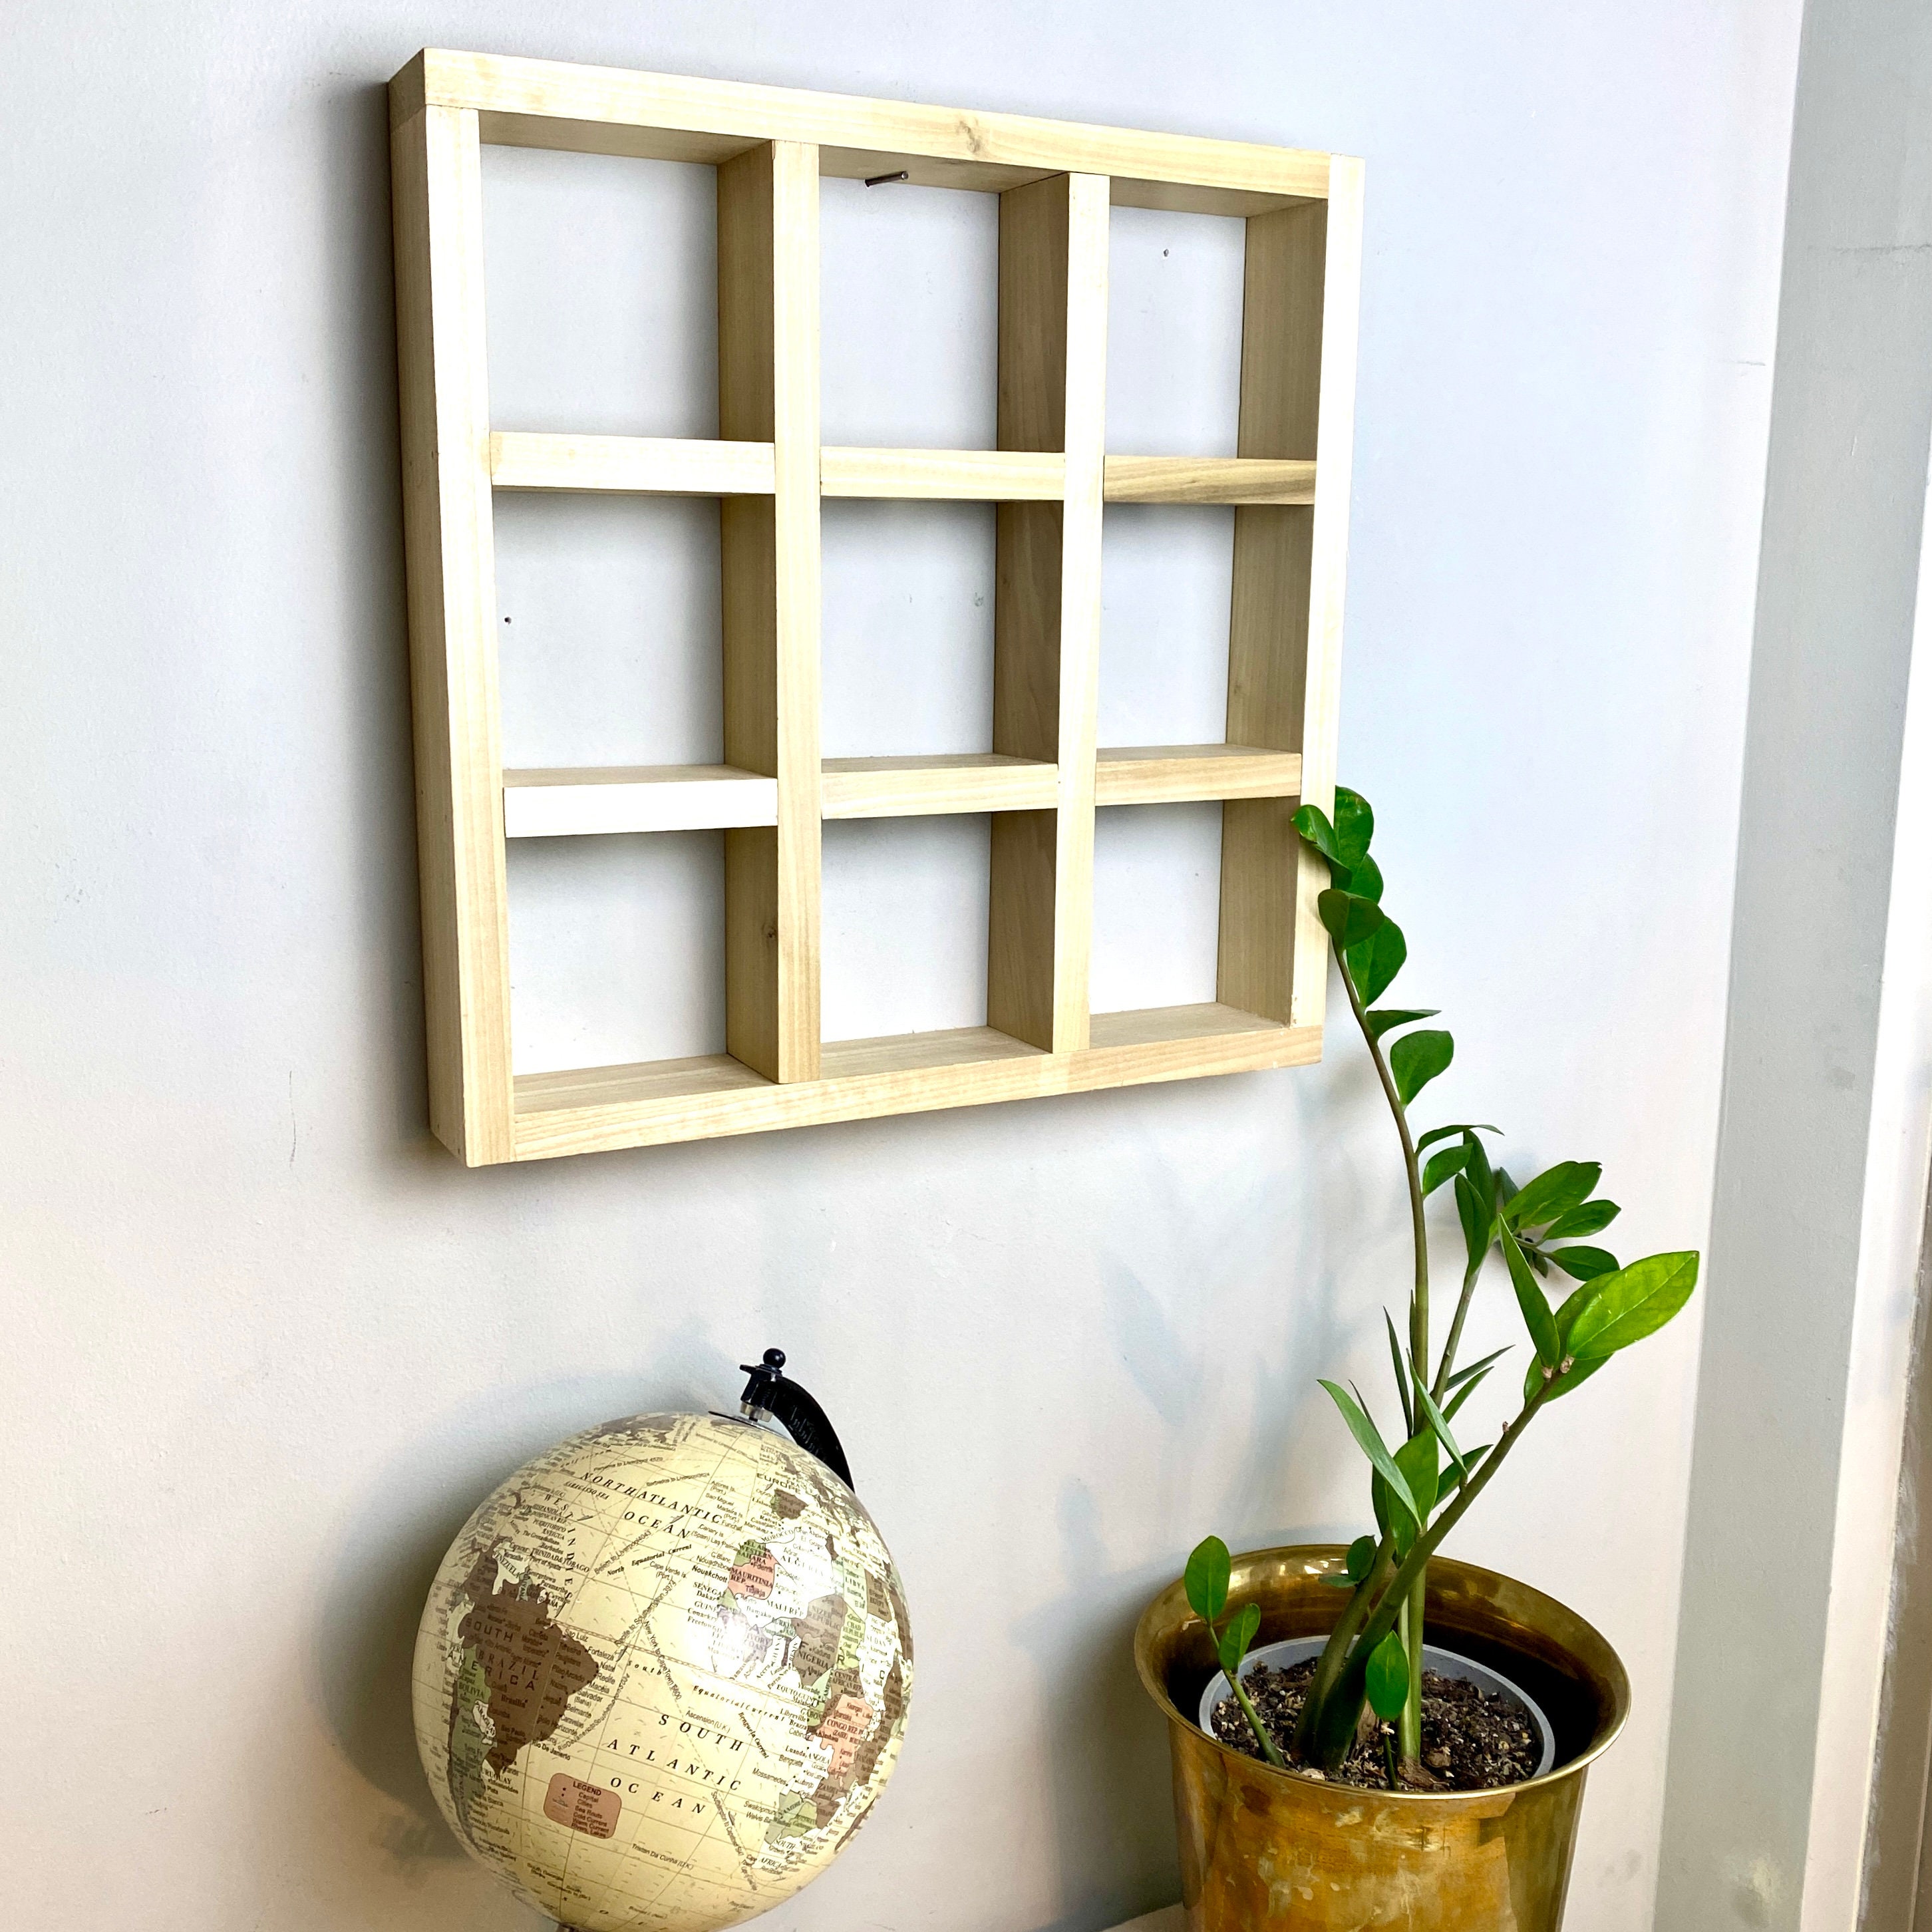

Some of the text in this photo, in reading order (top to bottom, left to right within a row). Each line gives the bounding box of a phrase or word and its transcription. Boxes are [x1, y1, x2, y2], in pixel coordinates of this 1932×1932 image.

[756, 1473, 800, 1494] EUROPE
[579, 1472, 637, 1498] NORTH
[637, 1491, 723, 1524] ATLANTIC
[624, 1511, 691, 1539] OCEAN
[465, 1617, 514, 1643] SOUTH
[478, 1650, 538, 1681] BRAZIL
[659, 1714, 744, 1751] SOUTH
[607, 1739, 740, 1791] ATLANTIC
[572, 1781, 602, 1796] LEGEND
[578, 1792, 599, 1803] Capital
[610, 1778, 705, 1814] OCEAN
[577, 1798, 593, 1808] Cities
